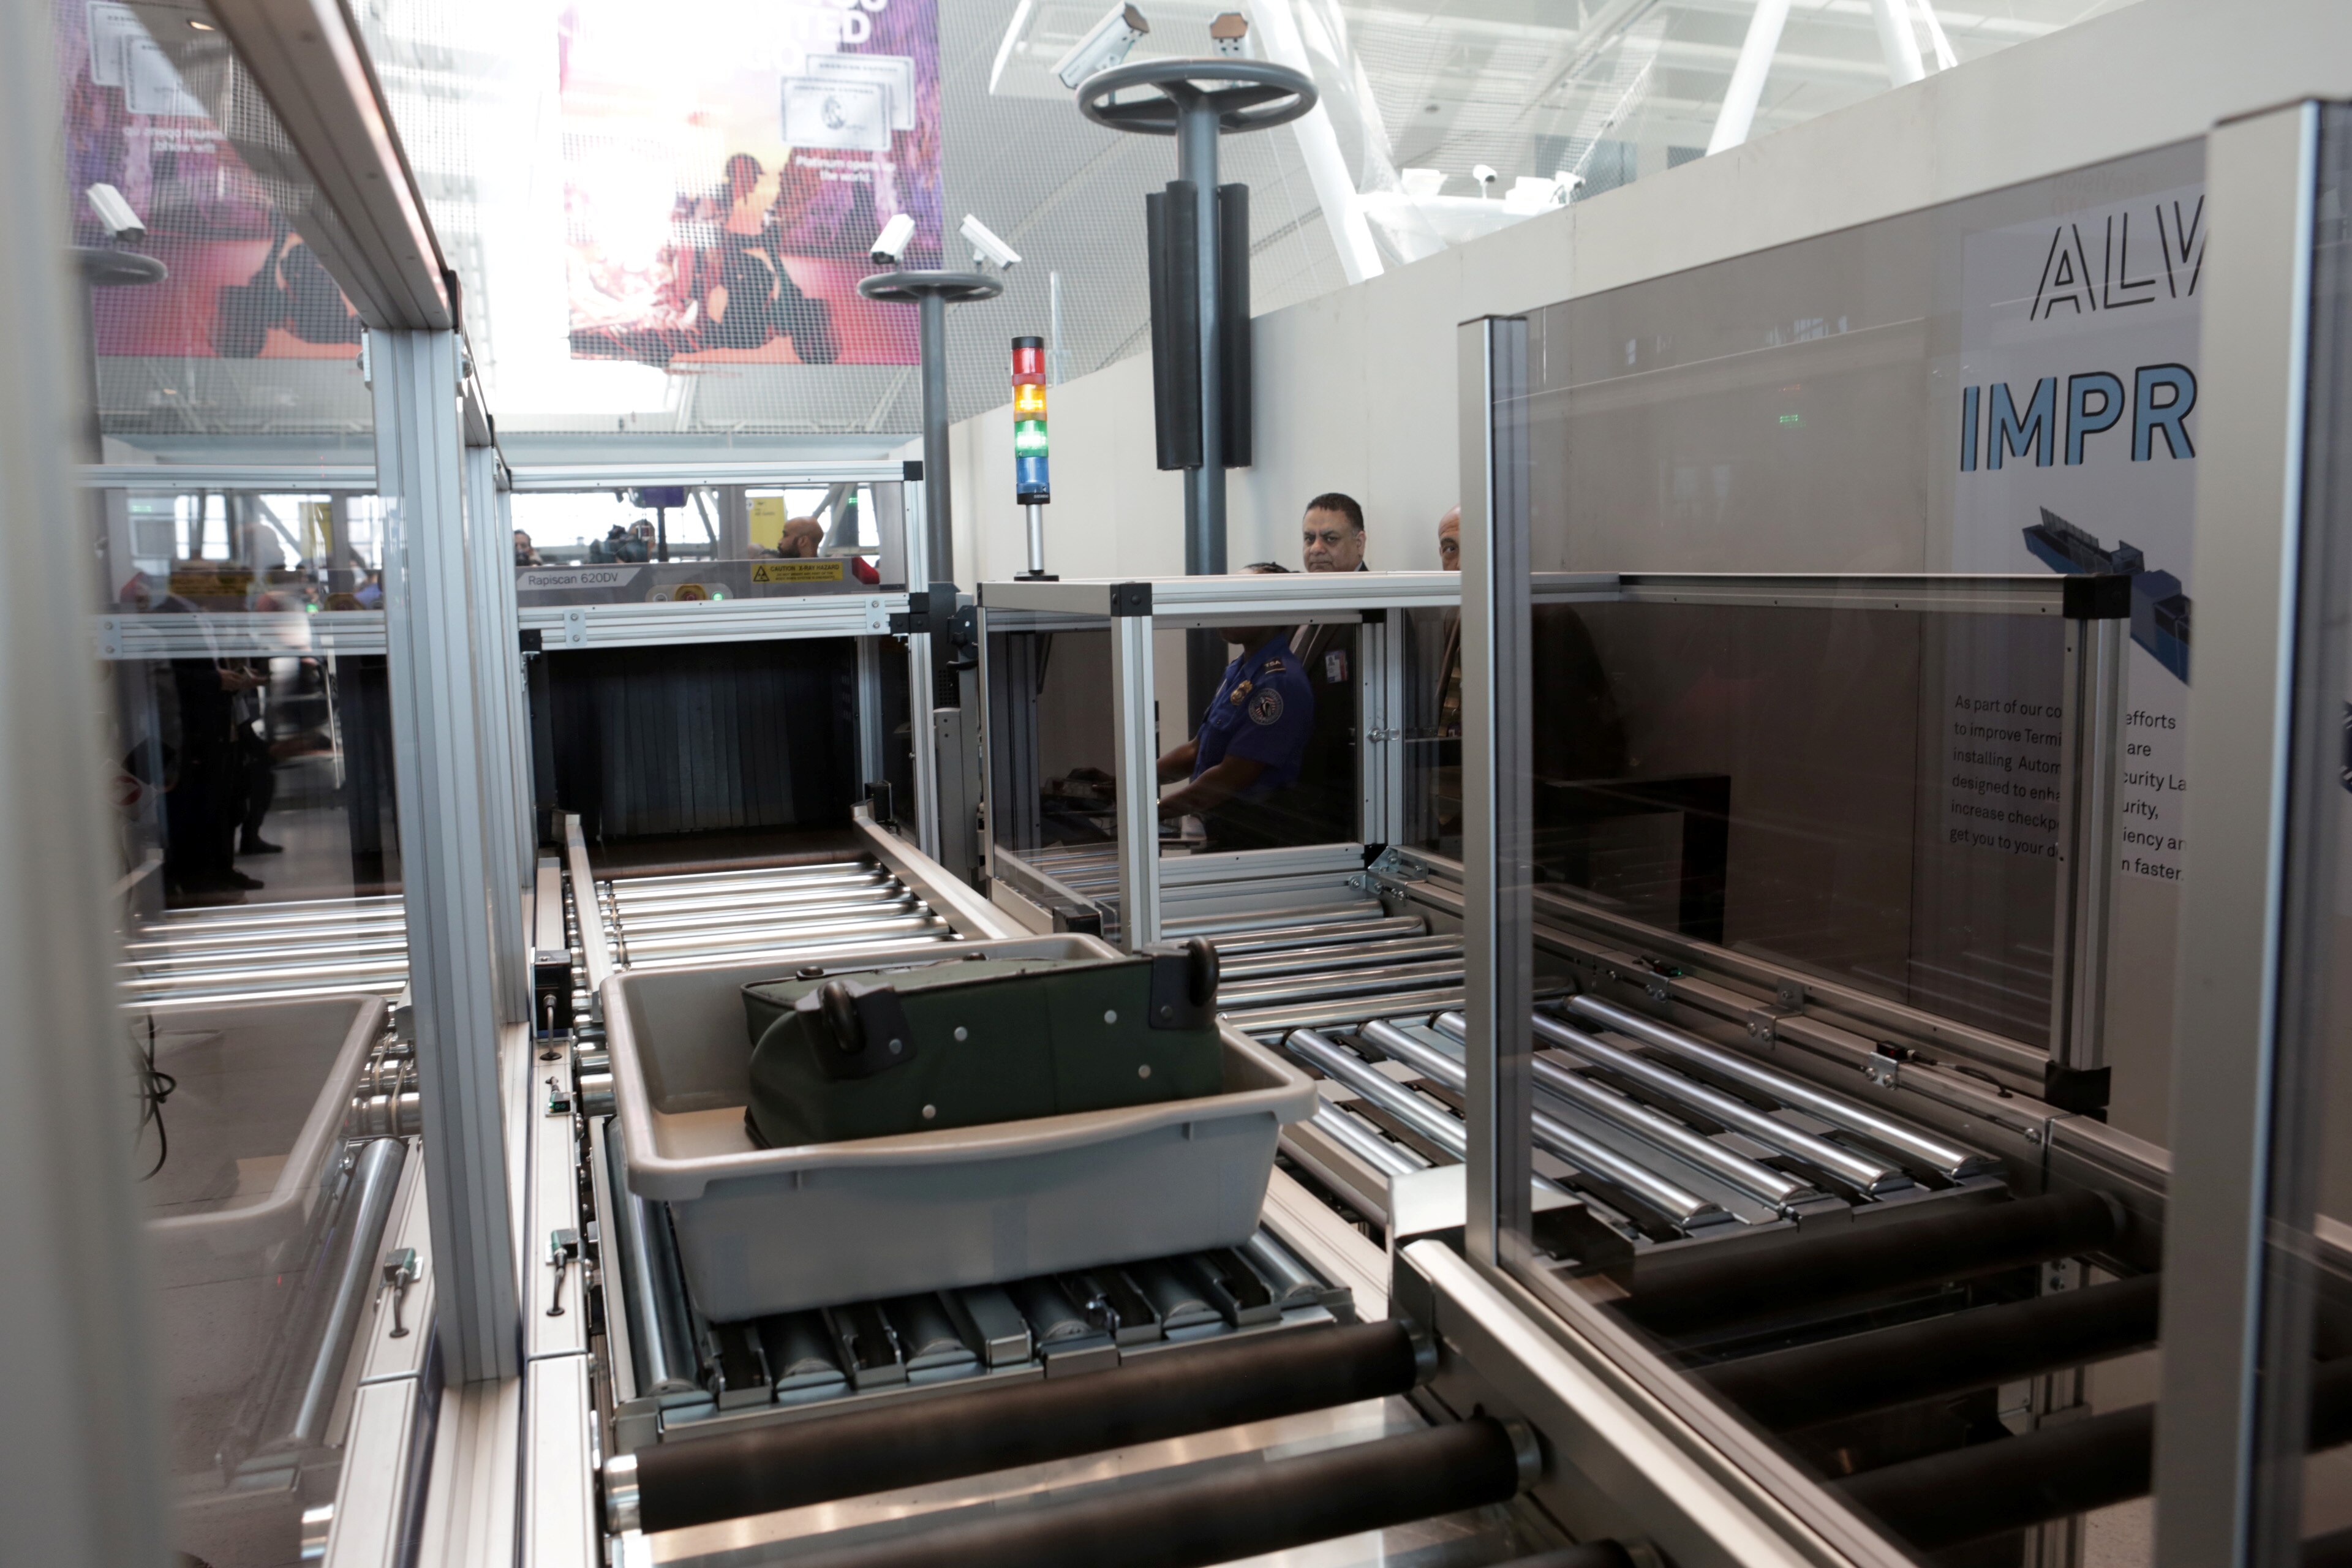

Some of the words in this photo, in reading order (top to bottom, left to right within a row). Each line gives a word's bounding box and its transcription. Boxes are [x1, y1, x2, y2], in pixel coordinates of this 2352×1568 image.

[1960, 363, 2198, 472] IMPR
[529, 575, 577, 587] Rapiscan
[581, 573, 618, 582] 620DV
[1954, 695, 1970, 709] As
[1974, 699, 2000, 714] part
[2004, 699, 2017, 714] of
[2020, 704, 2042, 715] our
[2046, 706, 2062, 718] co
[1954, 722, 1966, 736] to
[1970, 723, 2021, 742] improve
[2025, 728, 2062, 747] Termi
[2127, 743, 2151, 756] are
[1953, 747, 2013, 772] installing
[2169, 774, 2187, 791] La
[1952, 774, 2010, 795] designed
[2013, 783, 2026, 797] to
[1951, 799, 2005, 821] increase
[2008, 810, 2059, 833] checkp
[1950, 828, 1969, 843] get
[1972, 833, 1994, 846] you
[1998, 835, 2011, 849] to
[2015, 840, 2043, 854] your
[2047, 842, 2059, 857] d
